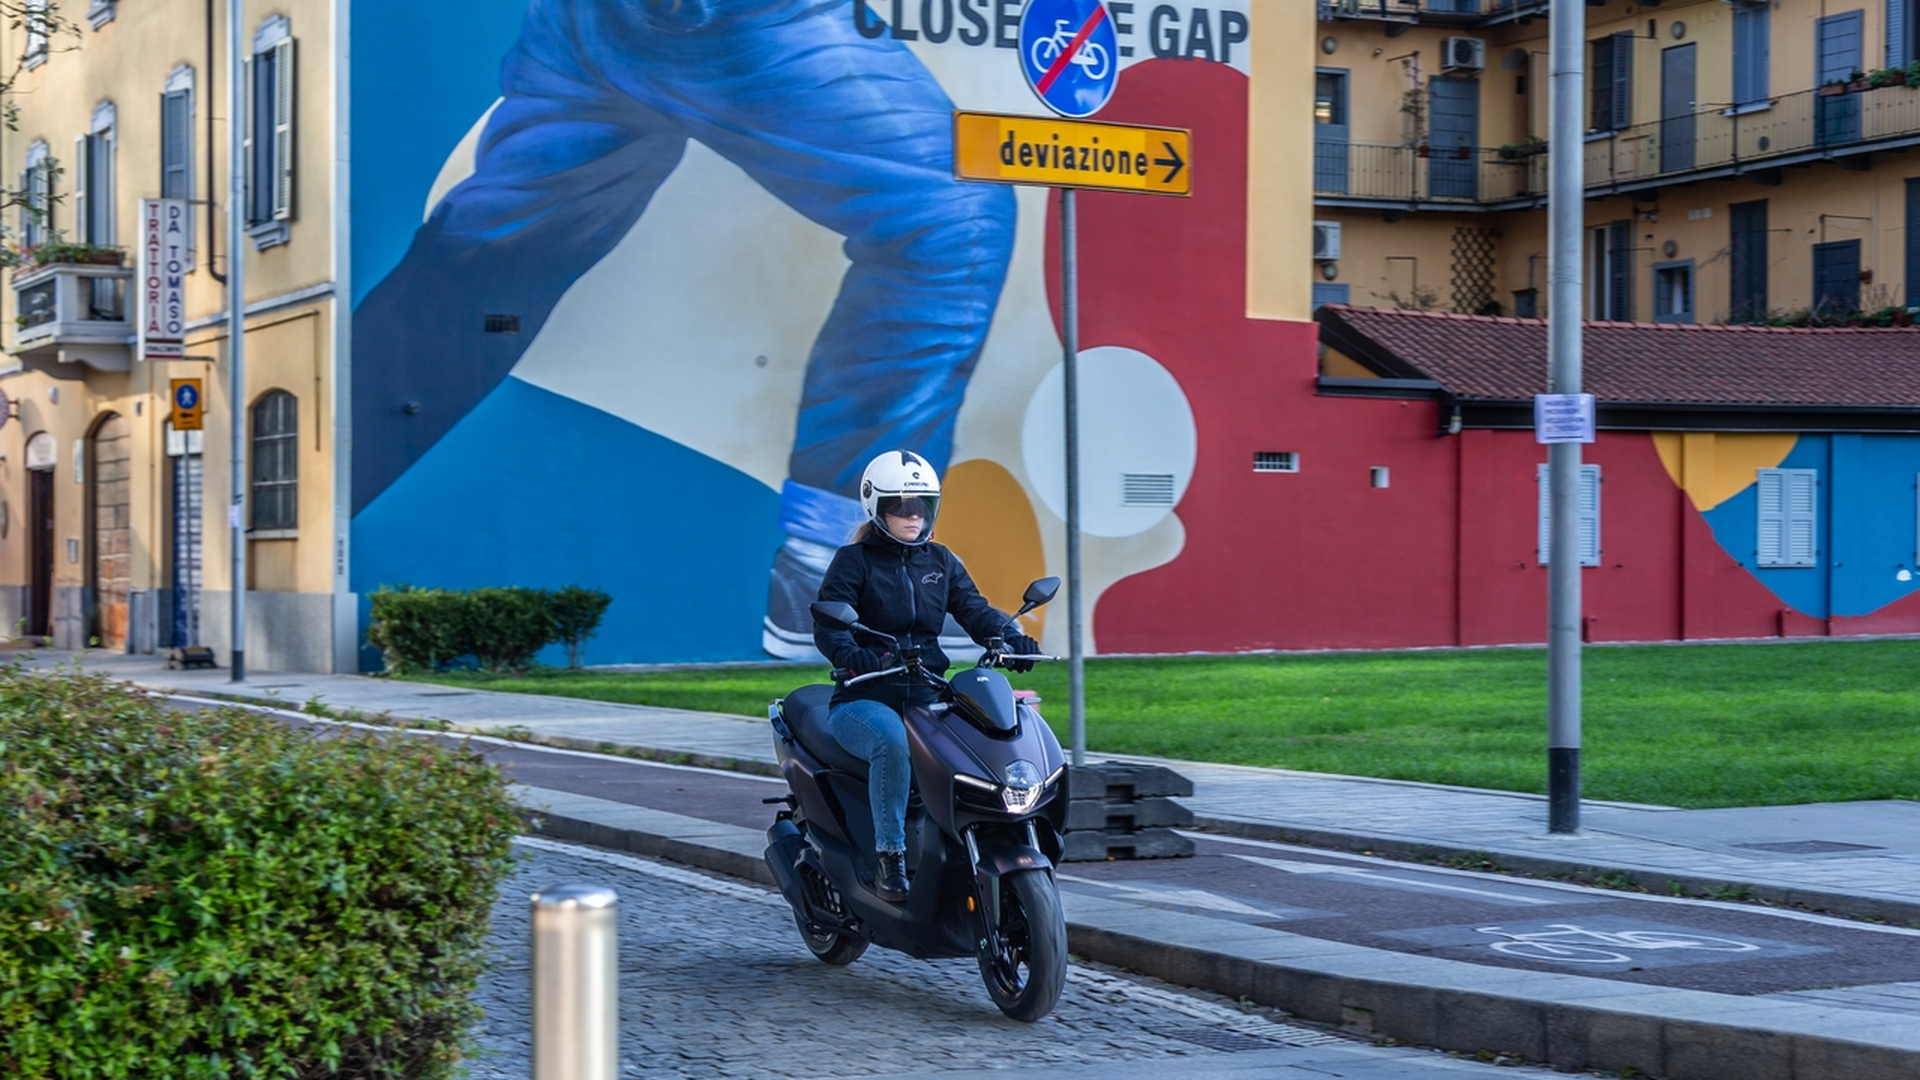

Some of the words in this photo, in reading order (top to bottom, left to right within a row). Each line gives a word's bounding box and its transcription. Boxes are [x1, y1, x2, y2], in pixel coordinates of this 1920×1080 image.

[853, 0, 1021, 49] CLOSE
[1149, 4, 1248, 63] GAP
[1001, 130, 1149, 177] deviazione
[167, 205, 182, 234] DA
[147, 203, 161, 333] TRATTORIA
[166, 245, 182, 335] TOMASO
